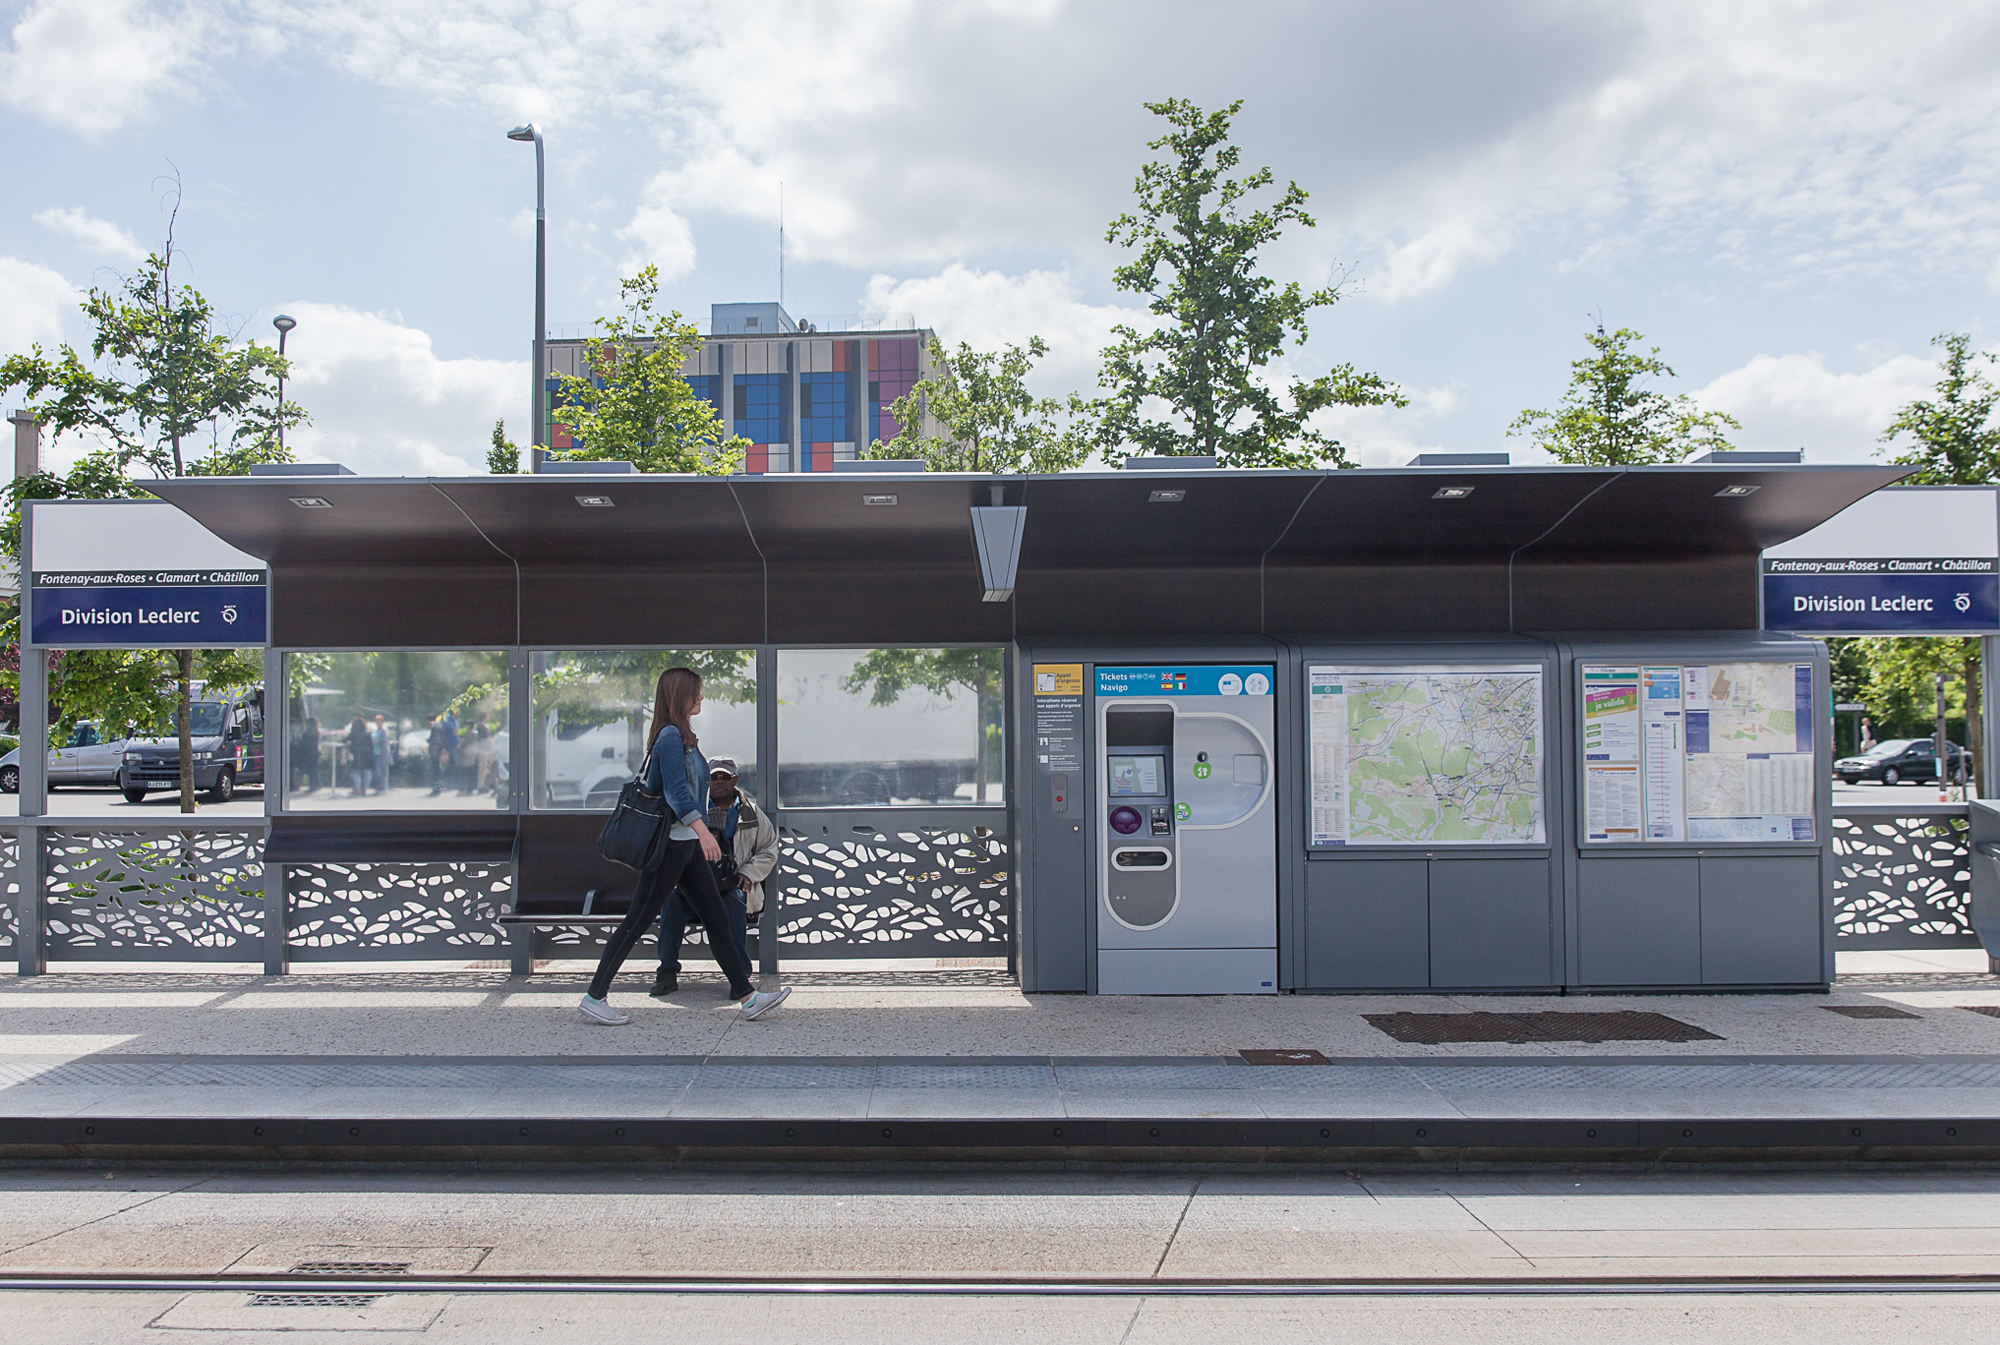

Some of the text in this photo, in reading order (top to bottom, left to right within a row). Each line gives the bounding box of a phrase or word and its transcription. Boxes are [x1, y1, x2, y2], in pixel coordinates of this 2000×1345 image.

[1771, 559, 1992, 573] Fontenay-aux-Roses Clamart Châtillon
[39, 571, 260, 586] Fontenay-aux-Roses Clamart Châtillon
[1793, 595, 1934, 612] Division Leclerc
[61, 607, 201, 625] Division Leclerc
[1100, 673, 1128, 681] Tickets
[1100, 684, 1128, 692] Navigo
